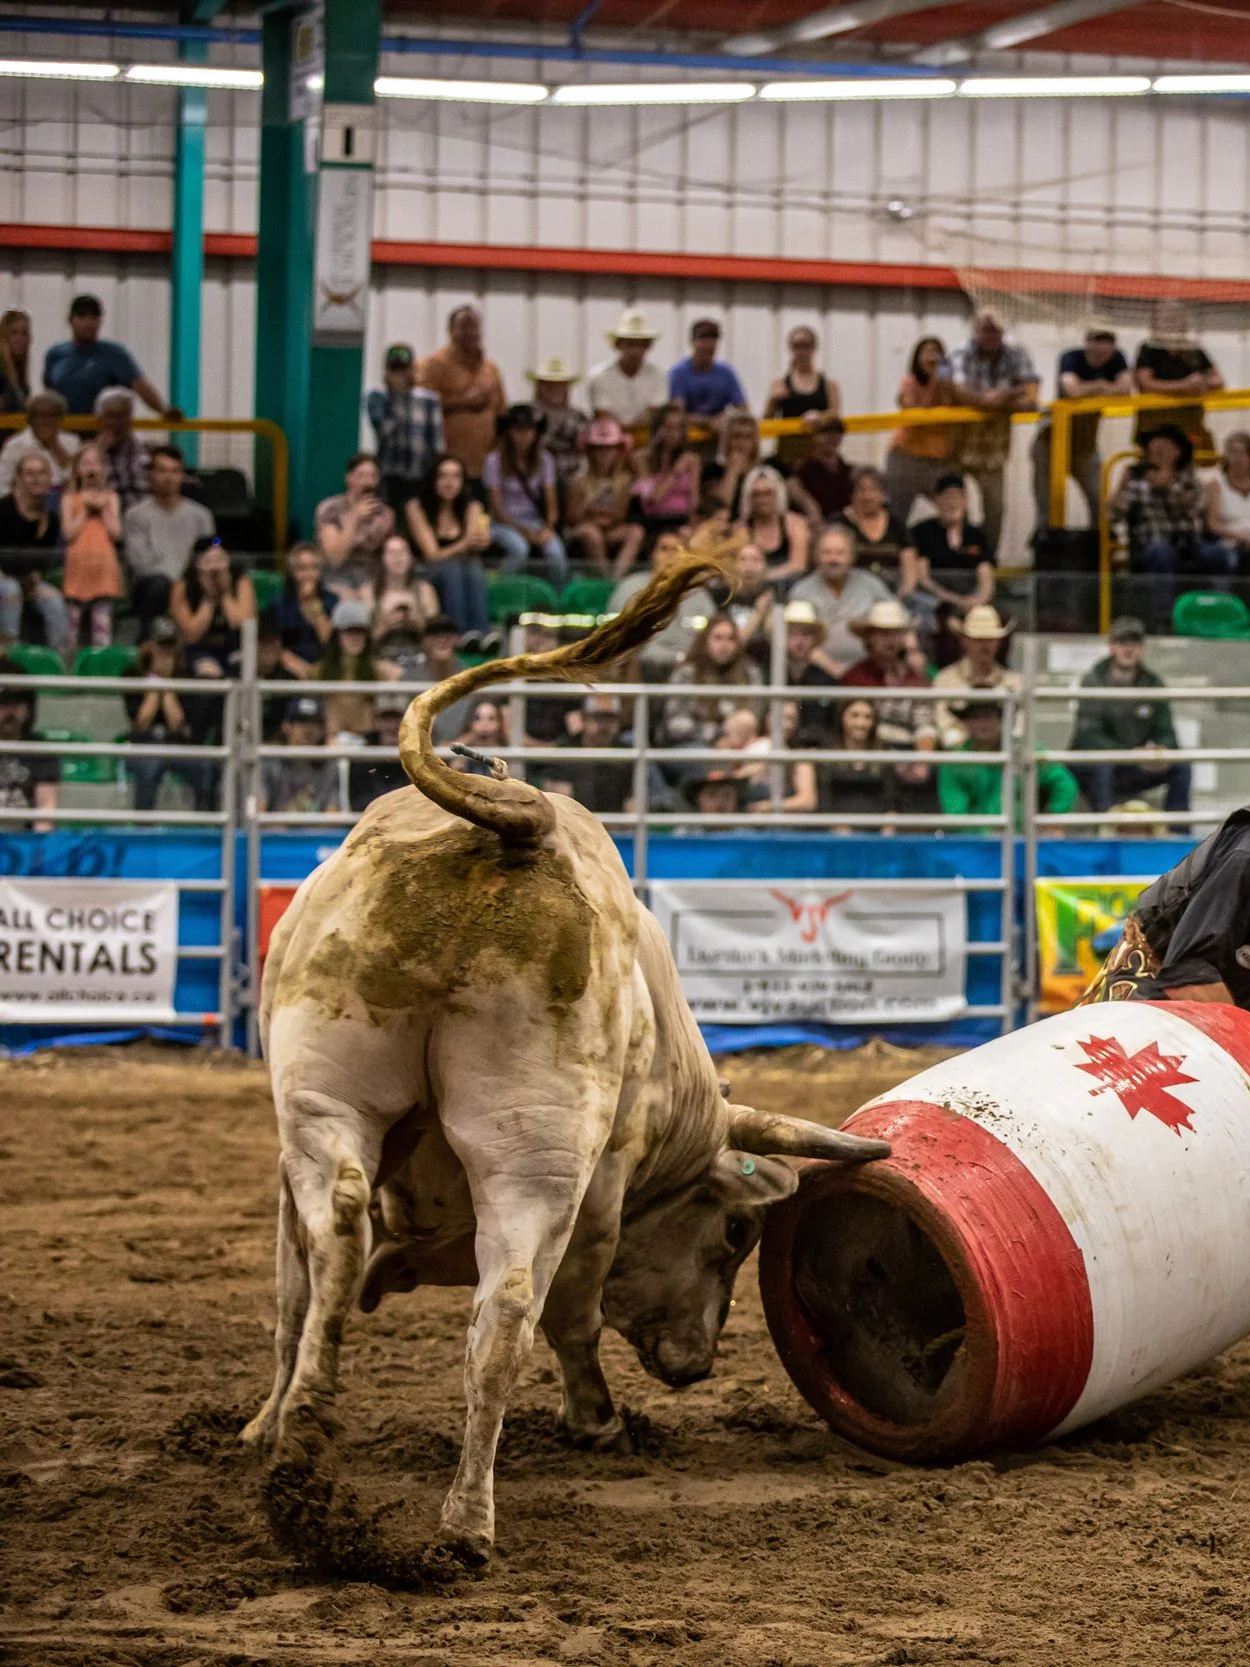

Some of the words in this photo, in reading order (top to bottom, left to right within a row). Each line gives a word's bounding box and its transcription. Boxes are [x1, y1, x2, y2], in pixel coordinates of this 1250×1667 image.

[0, 907, 34, 931] ALL
[45, 907, 157, 933] CHOICE
[0, 940, 158, 976] RENTALS
